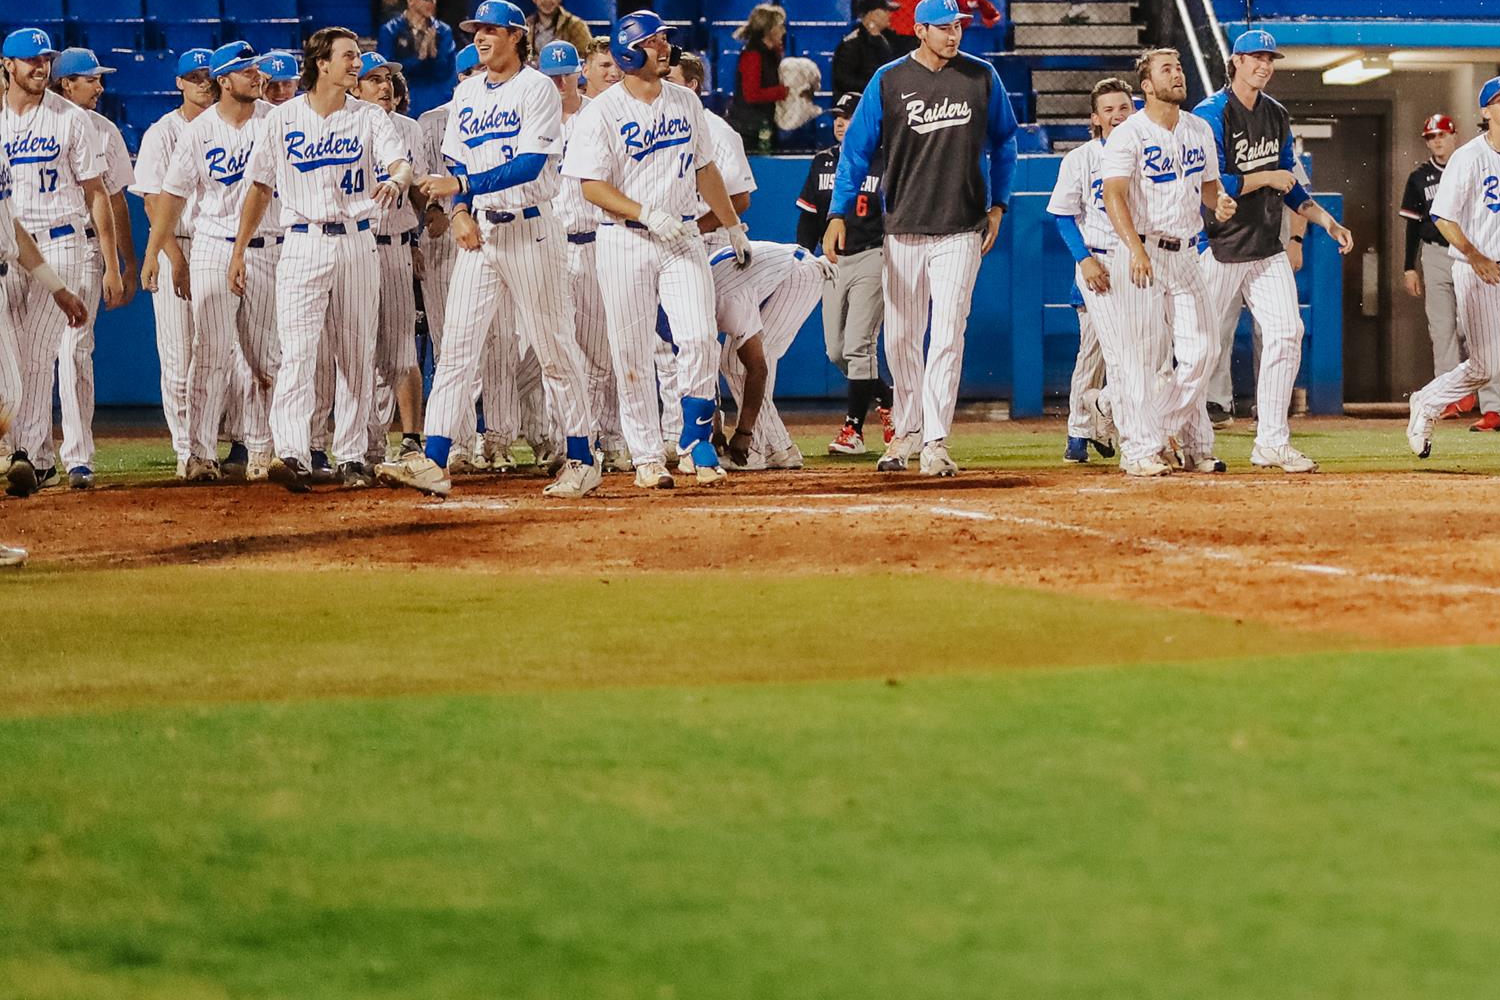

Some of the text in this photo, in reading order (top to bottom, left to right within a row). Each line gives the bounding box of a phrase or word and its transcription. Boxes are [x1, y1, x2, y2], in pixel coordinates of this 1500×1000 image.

[458, 104, 521, 136] Raiders
[906, 97, 972, 126] Raiders
[4, 130, 61, 158] iders
[285, 131, 363, 161] Raiders
[620, 113, 692, 153] Raiders
[205, 140, 254, 178] Raid
[1143, 143, 1206, 172] Raers
[1235, 136, 1280, 165] Raiders
[39, 167, 58, 194] 17
[340, 168, 365, 194] 40
[856, 195, 869, 217] 6
